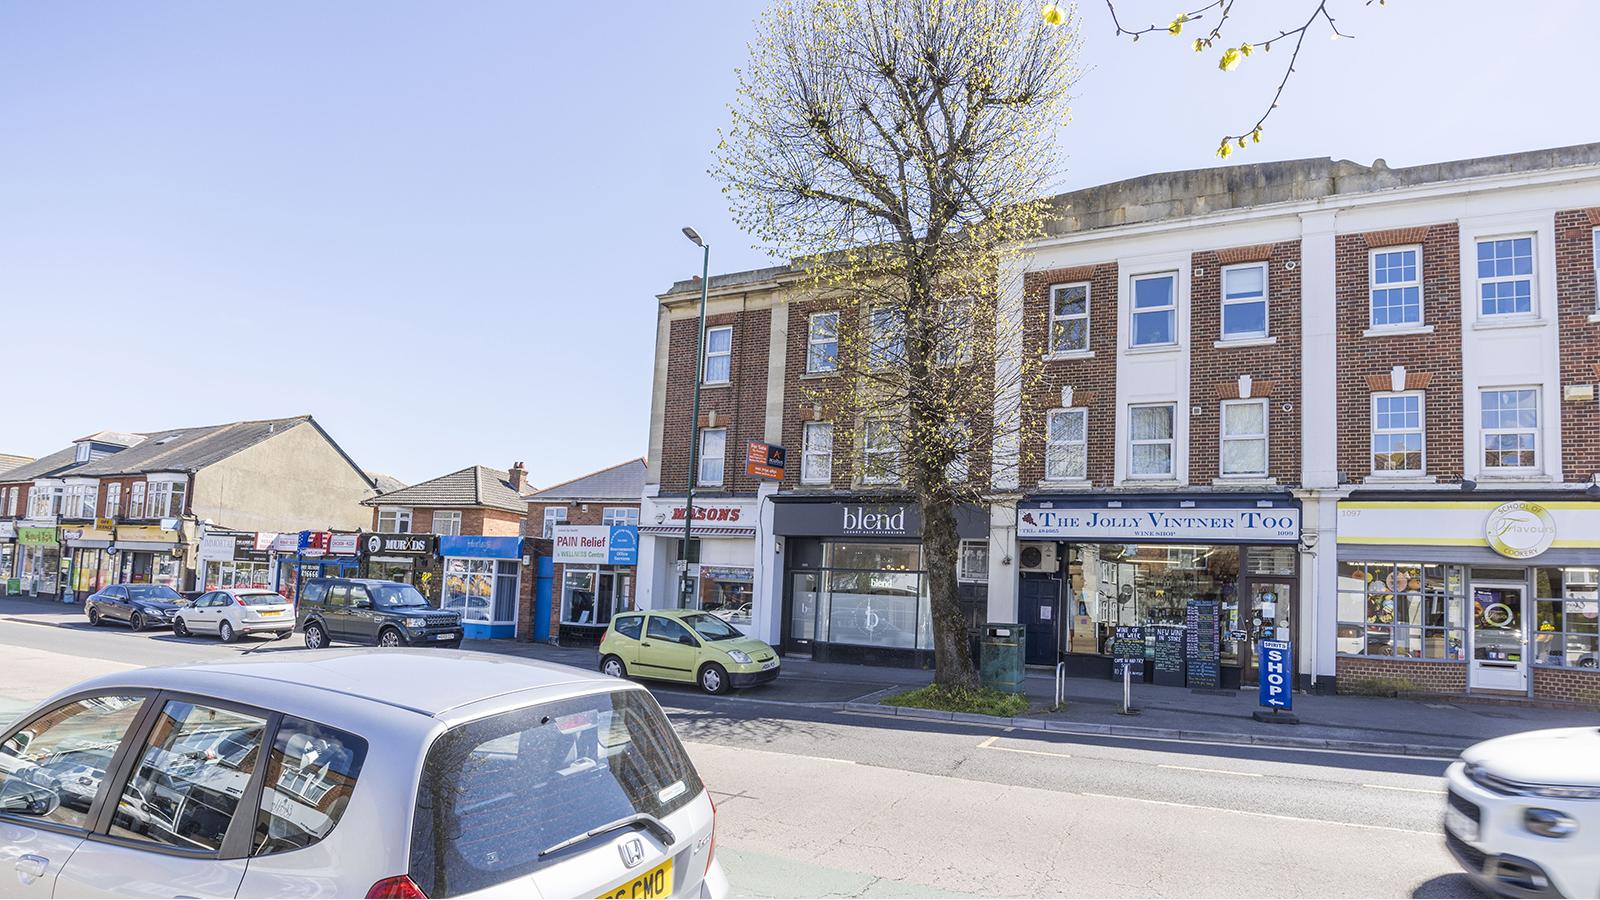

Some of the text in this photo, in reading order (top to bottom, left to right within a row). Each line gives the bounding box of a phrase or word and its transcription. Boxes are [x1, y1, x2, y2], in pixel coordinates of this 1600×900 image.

[1497, 502, 1543, 514] SCHOOL OF
[671, 507, 741, 521] MASONS
[843, 507, 905, 530] blend
[1341, 510, 1361, 518] 1097
[1038, 512, 1293, 529] THE JOLLY VINTNER TOO
[557, 536, 606, 547] PAIN Relief
[561, 550, 587, 558] WELLNESS
[1503, 548, 1538, 557] COOKERY
[870, 578, 893, 588] blend
[1157, 628, 1184, 637] NEW WINE
[1267, 650, 1283, 696] SHOP
